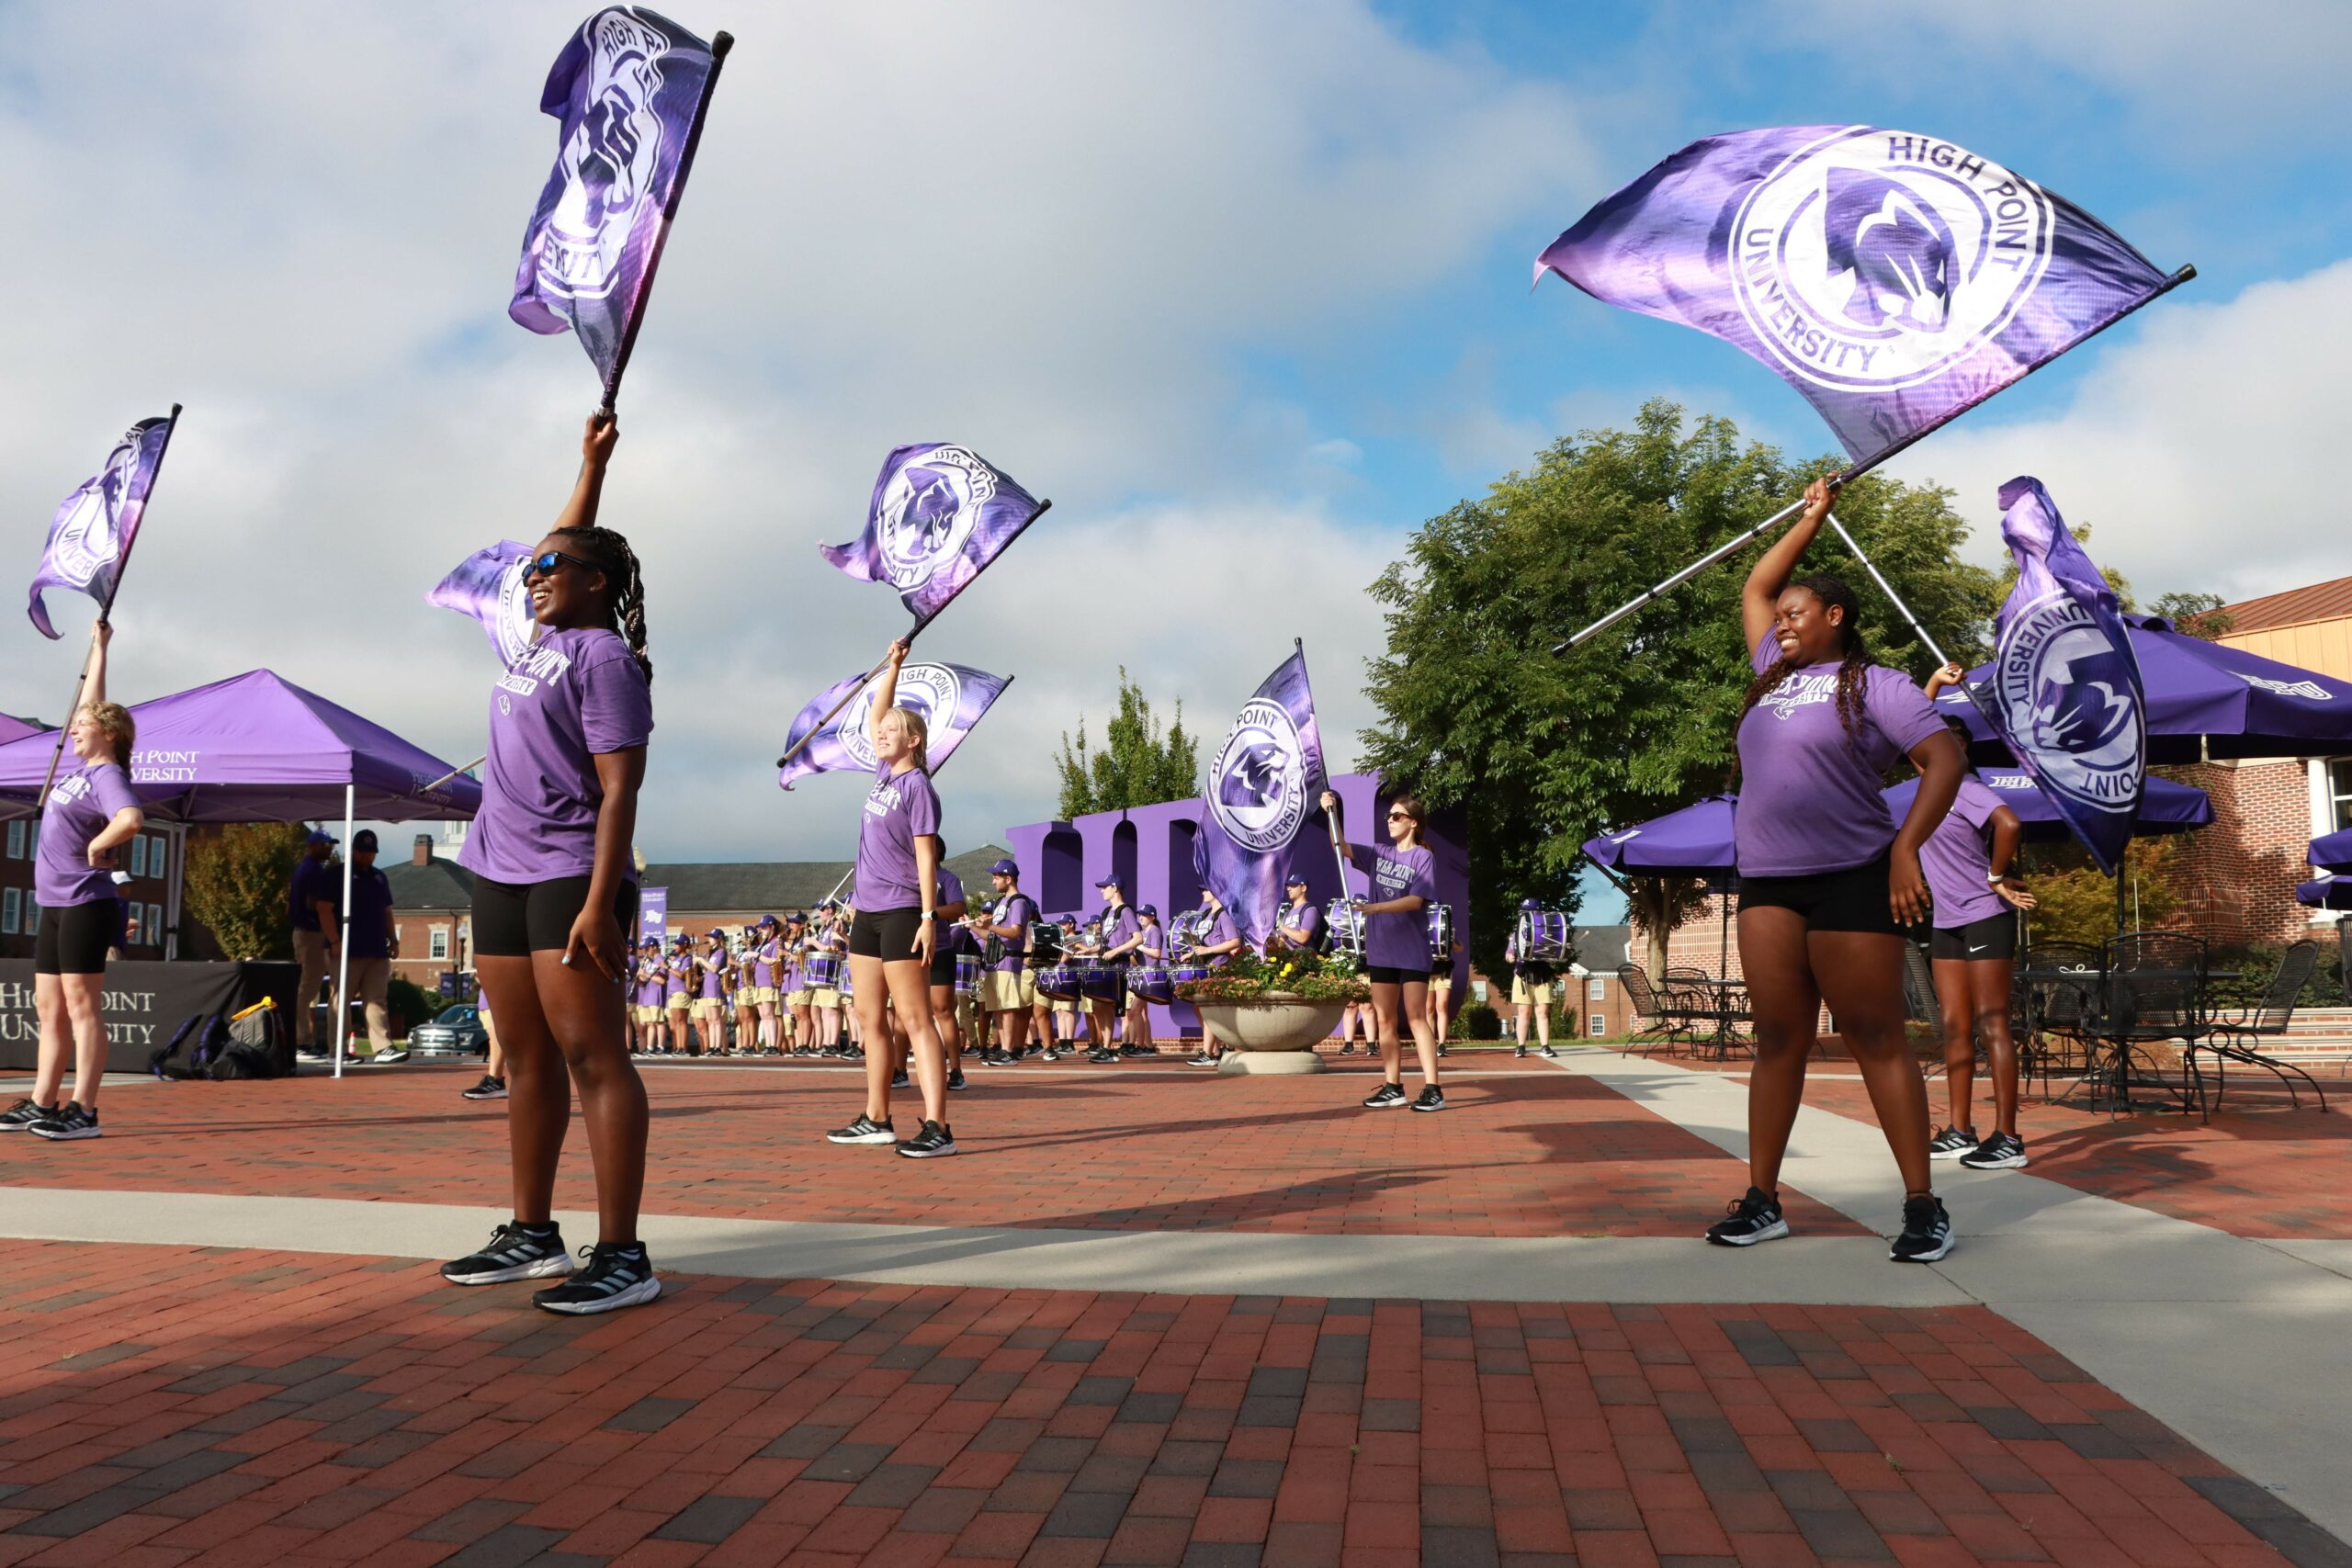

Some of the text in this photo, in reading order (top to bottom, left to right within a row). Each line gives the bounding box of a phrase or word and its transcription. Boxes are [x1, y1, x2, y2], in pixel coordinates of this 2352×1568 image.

[1888, 136, 2028, 272] HIGH POINT
[1746, 227, 1881, 373] UNIVERSITY
[2007, 602, 2093, 707] UNIVERSITY
[900, 669, 953, 702] IGH POINT
[1792, 674, 1838, 694] POIN
[1236, 709, 1279, 729] POINT
[844, 726, 877, 763] UNIVER
[130, 767, 198, 782] VERSITY
[1245, 786, 1299, 846] UNIVERSITY
[100, 990, 156, 1012] OINT
